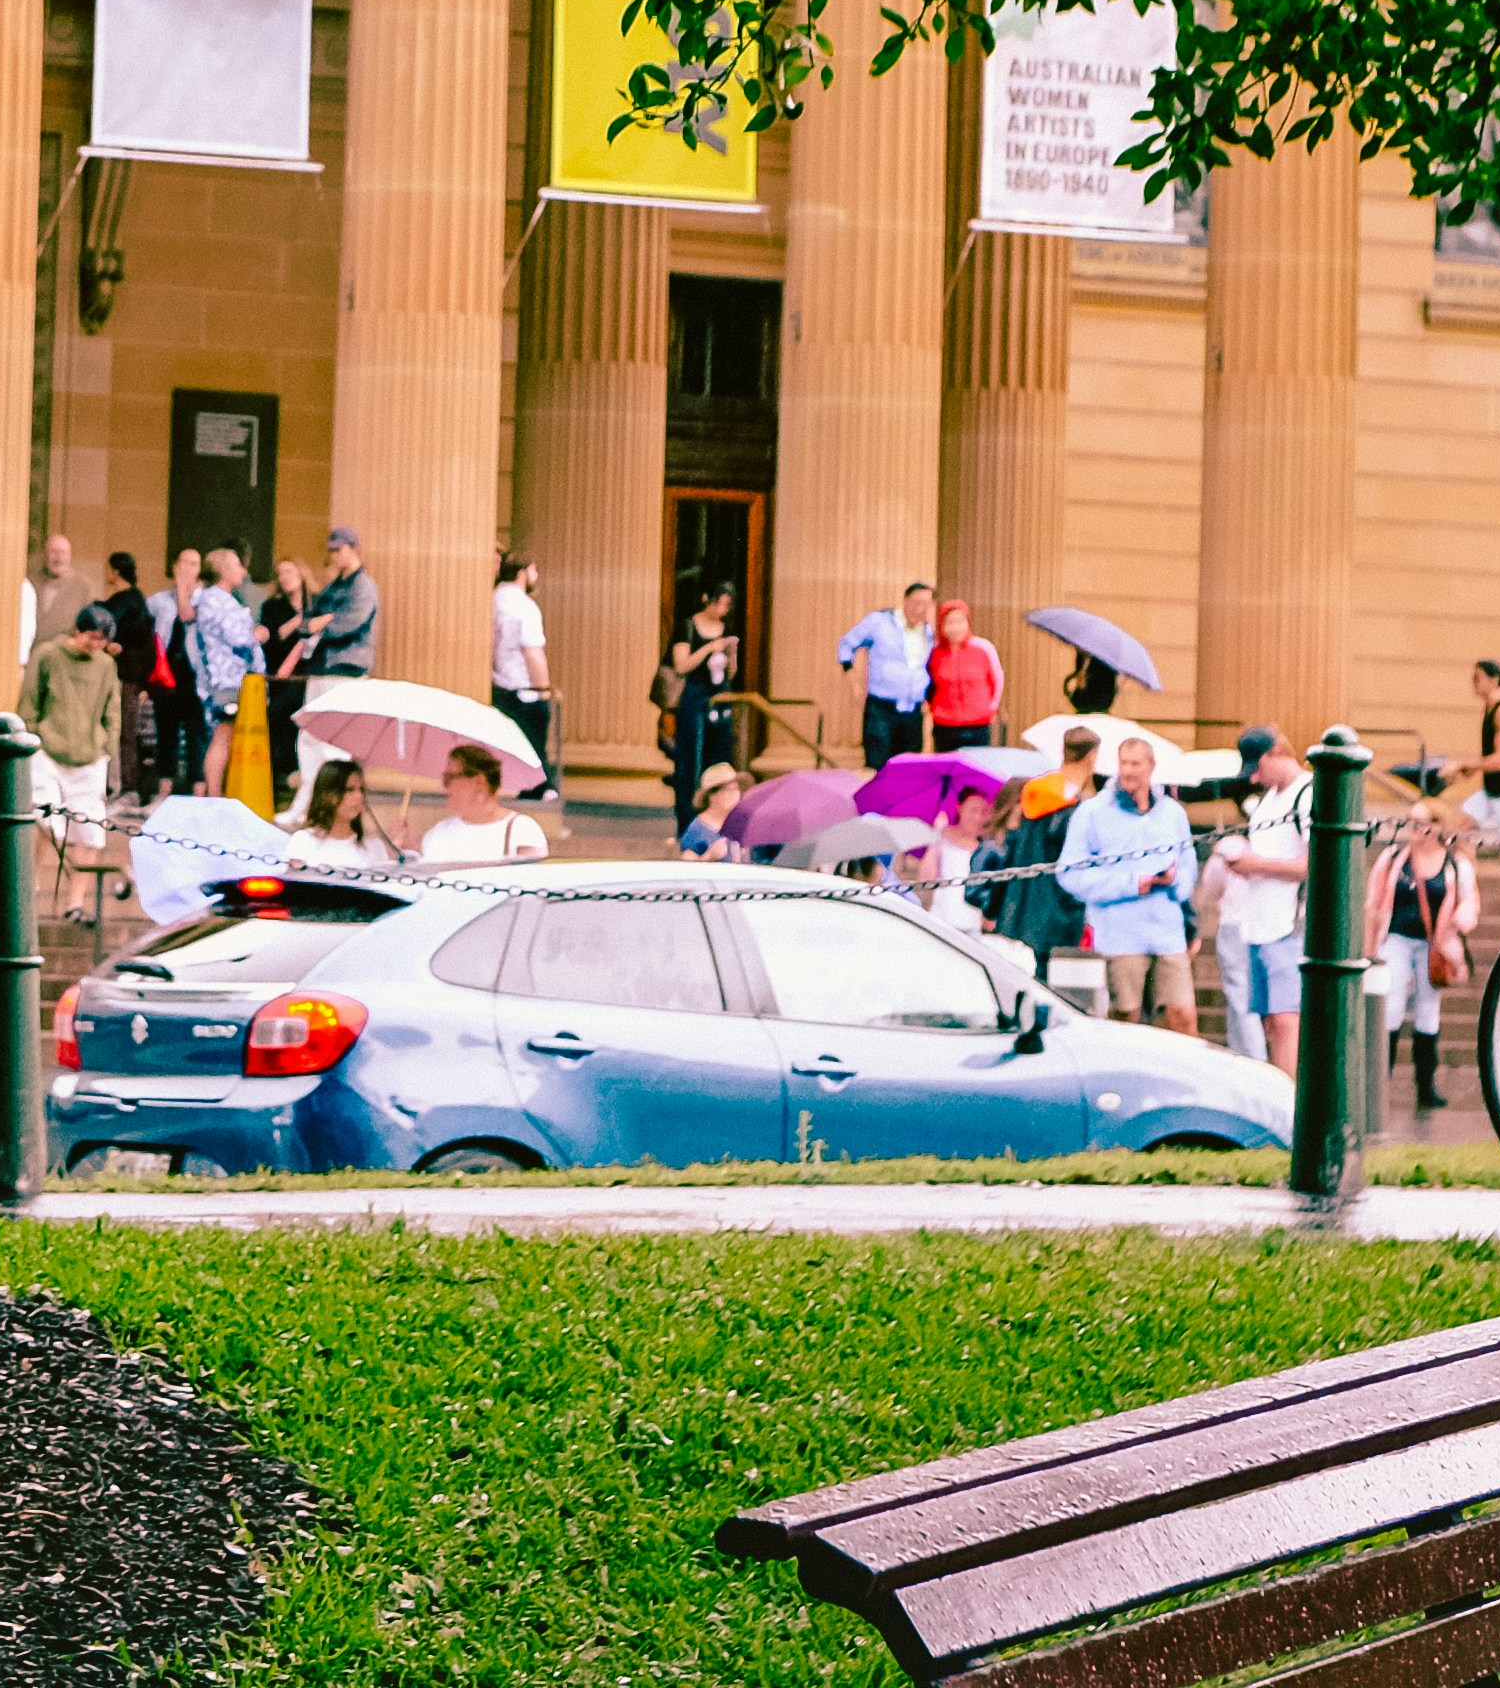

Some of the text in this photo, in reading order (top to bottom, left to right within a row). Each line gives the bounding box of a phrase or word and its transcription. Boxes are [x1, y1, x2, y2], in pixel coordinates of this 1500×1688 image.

[1009, 58, 1142, 87] AUSTRALIAN
[1007, 86, 1089, 110] WOMEN
[1007, 113, 1096, 139] ARTISTS
[1006, 142, 1111, 167] IN EUROPE
